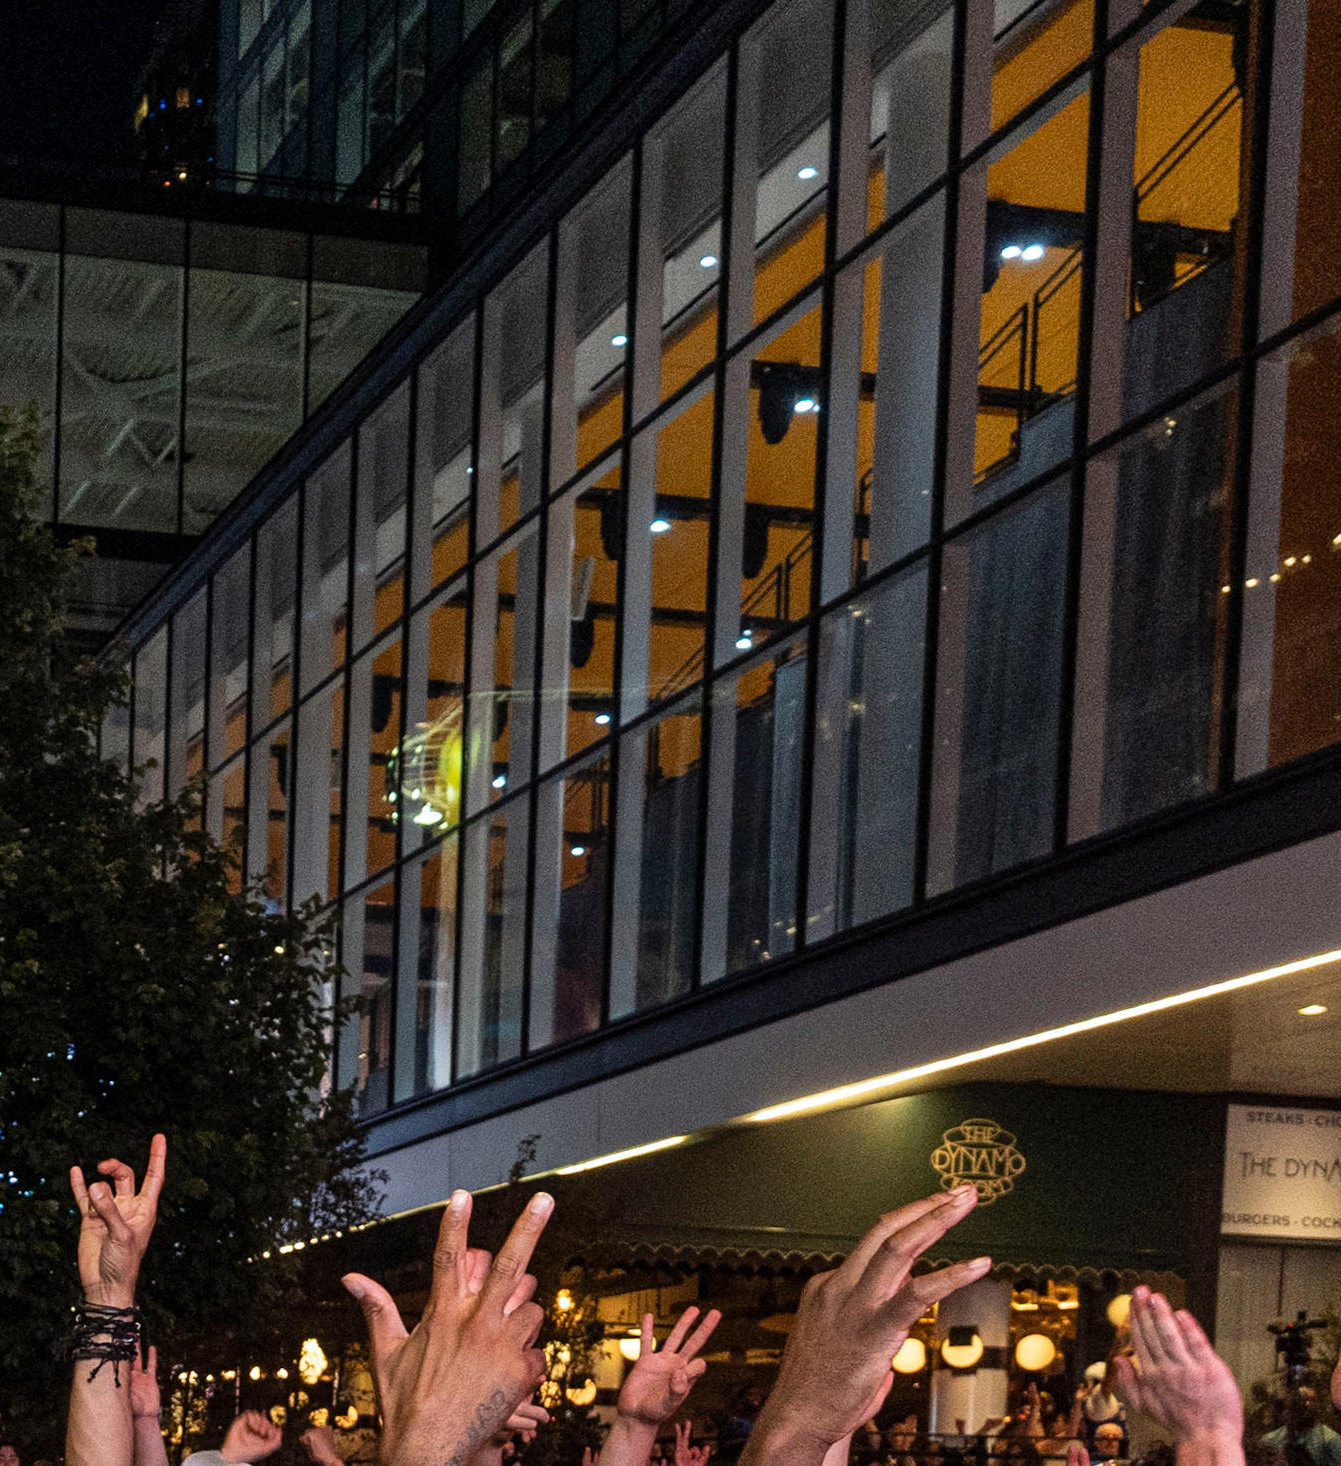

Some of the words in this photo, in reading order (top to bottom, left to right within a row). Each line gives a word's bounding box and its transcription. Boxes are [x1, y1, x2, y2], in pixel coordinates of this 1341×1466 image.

[1245, 1111, 1304, 1125] STEAKS
[931, 1142, 1026, 1178] DYNAMO
[1239, 1151, 1278, 1177] THE
